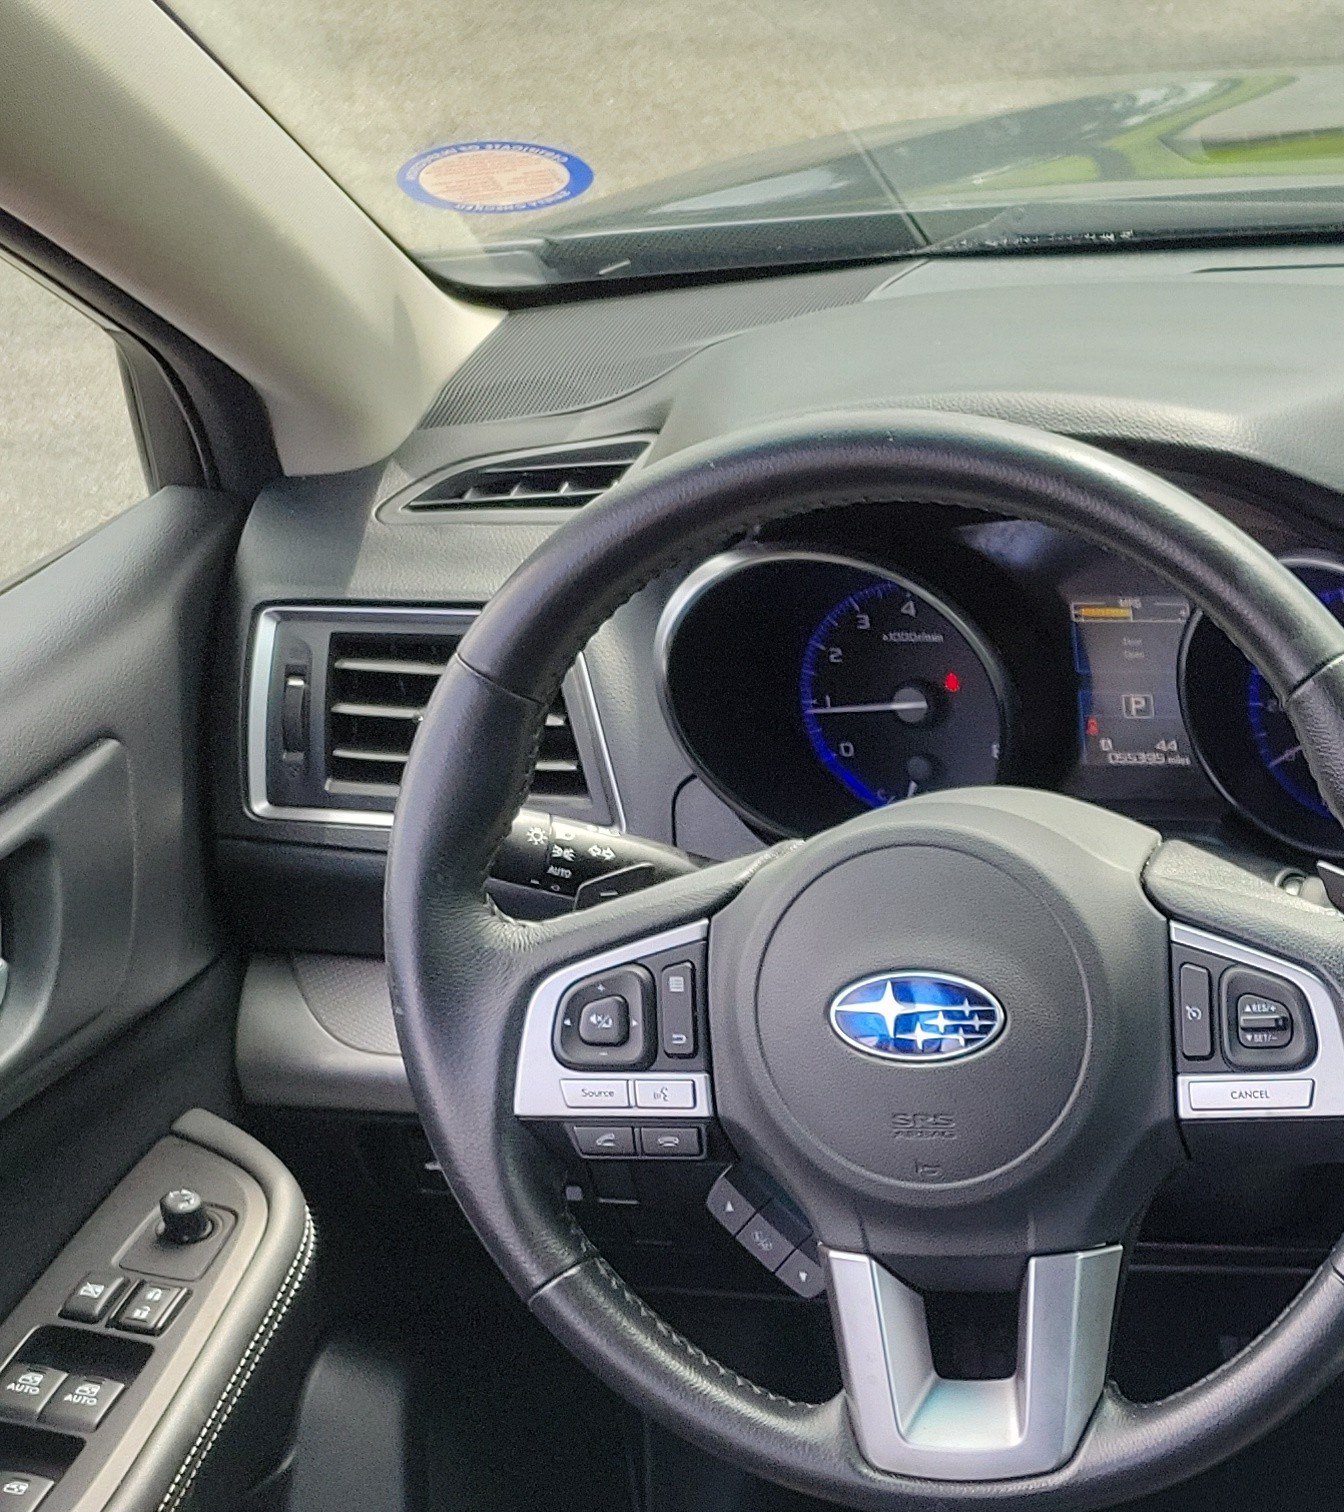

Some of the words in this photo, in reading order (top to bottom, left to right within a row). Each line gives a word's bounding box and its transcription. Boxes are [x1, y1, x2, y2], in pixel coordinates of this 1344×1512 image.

[856, 613, 871, 630] 3
[828, 647, 843, 663] 2
[838, 742, 855, 758] 0
[546, 865, 572, 879] AUTO
[581, 1087, 615, 1098] Source
[1230, 1089, 1270, 1100] CANCEL
[6, 1382, 40, 1395] AUTO
[63, 1393, 98, 1407] AUTO
